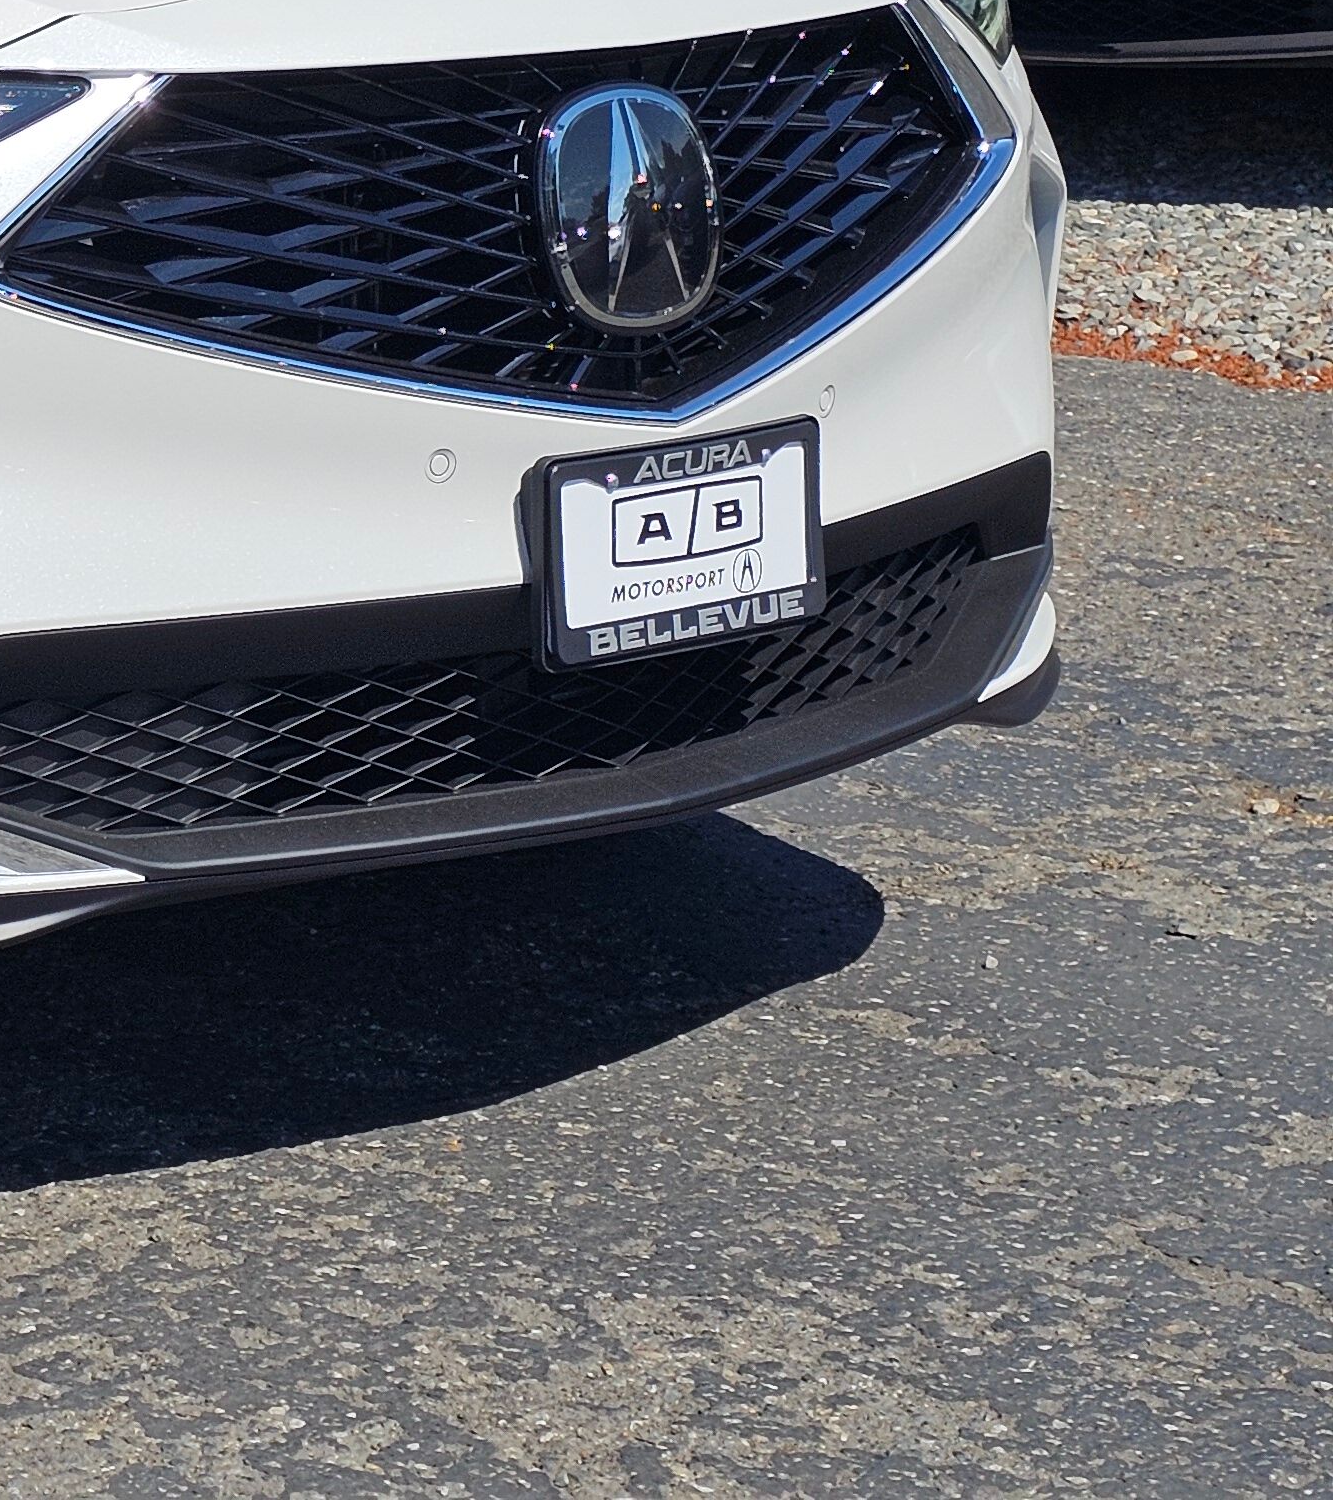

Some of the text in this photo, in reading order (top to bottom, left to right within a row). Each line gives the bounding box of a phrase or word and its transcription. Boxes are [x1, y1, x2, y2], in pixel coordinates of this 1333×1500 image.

[633, 439, 753, 484] ACURA
[611, 567, 726, 604] MOTORSPORT
[586, 589, 805, 658] BELLEVUE
